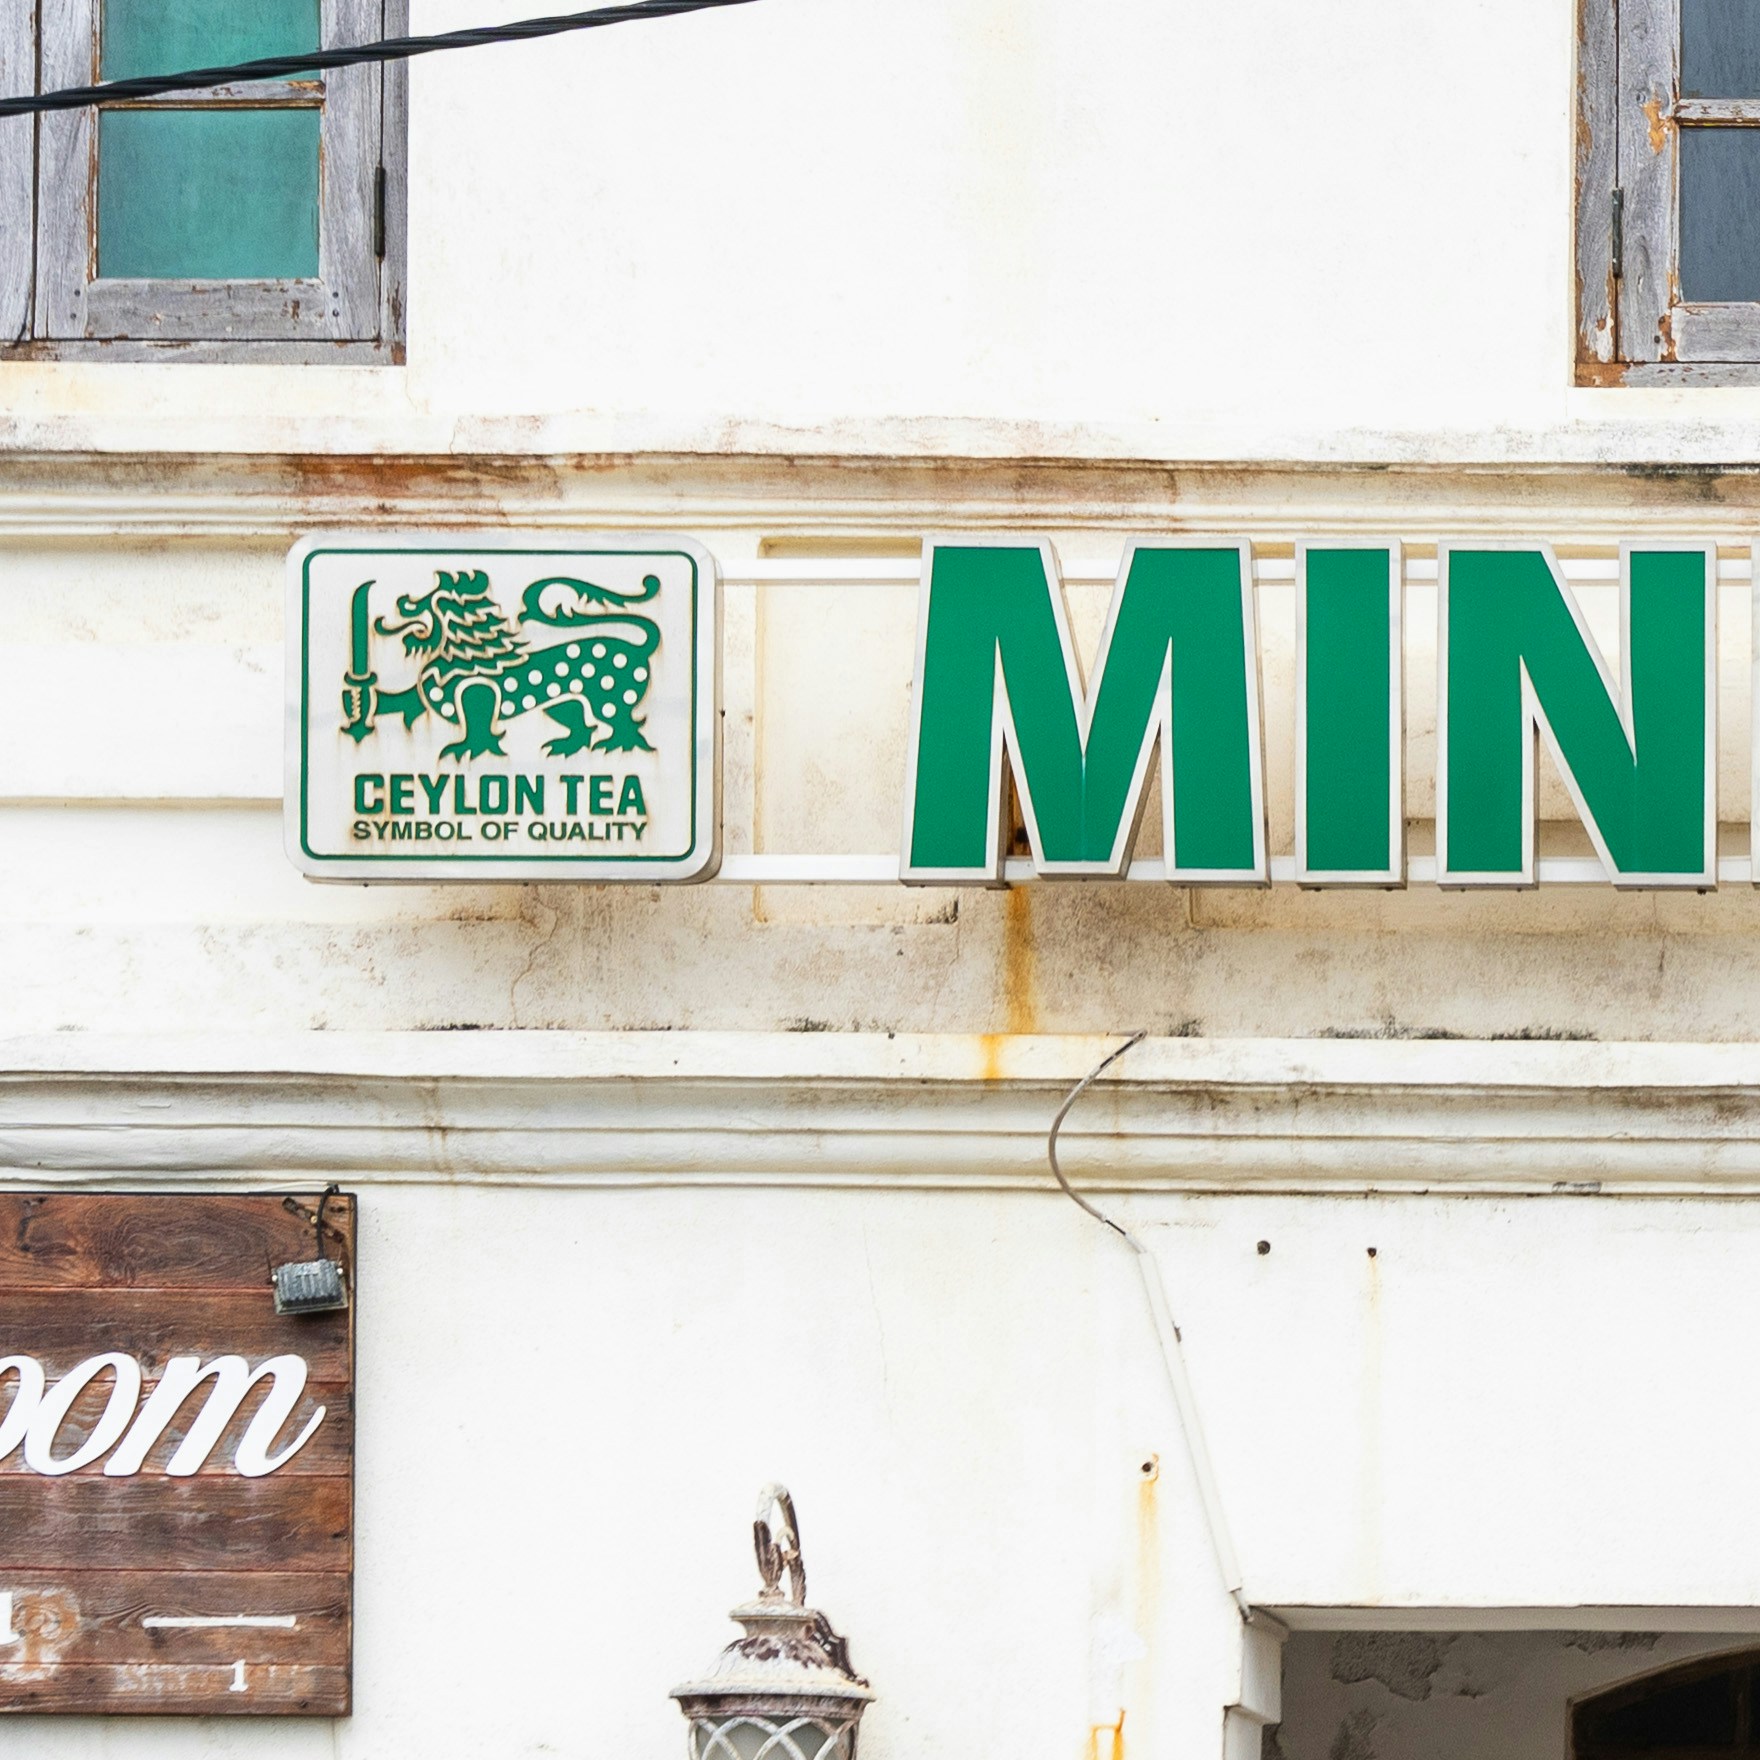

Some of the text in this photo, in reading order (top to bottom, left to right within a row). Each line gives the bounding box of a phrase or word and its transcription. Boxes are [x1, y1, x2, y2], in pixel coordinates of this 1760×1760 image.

[353, 773, 648, 816] CEYLON TEA
[352, 820, 648, 843] SYMBOL OF QUALITY
